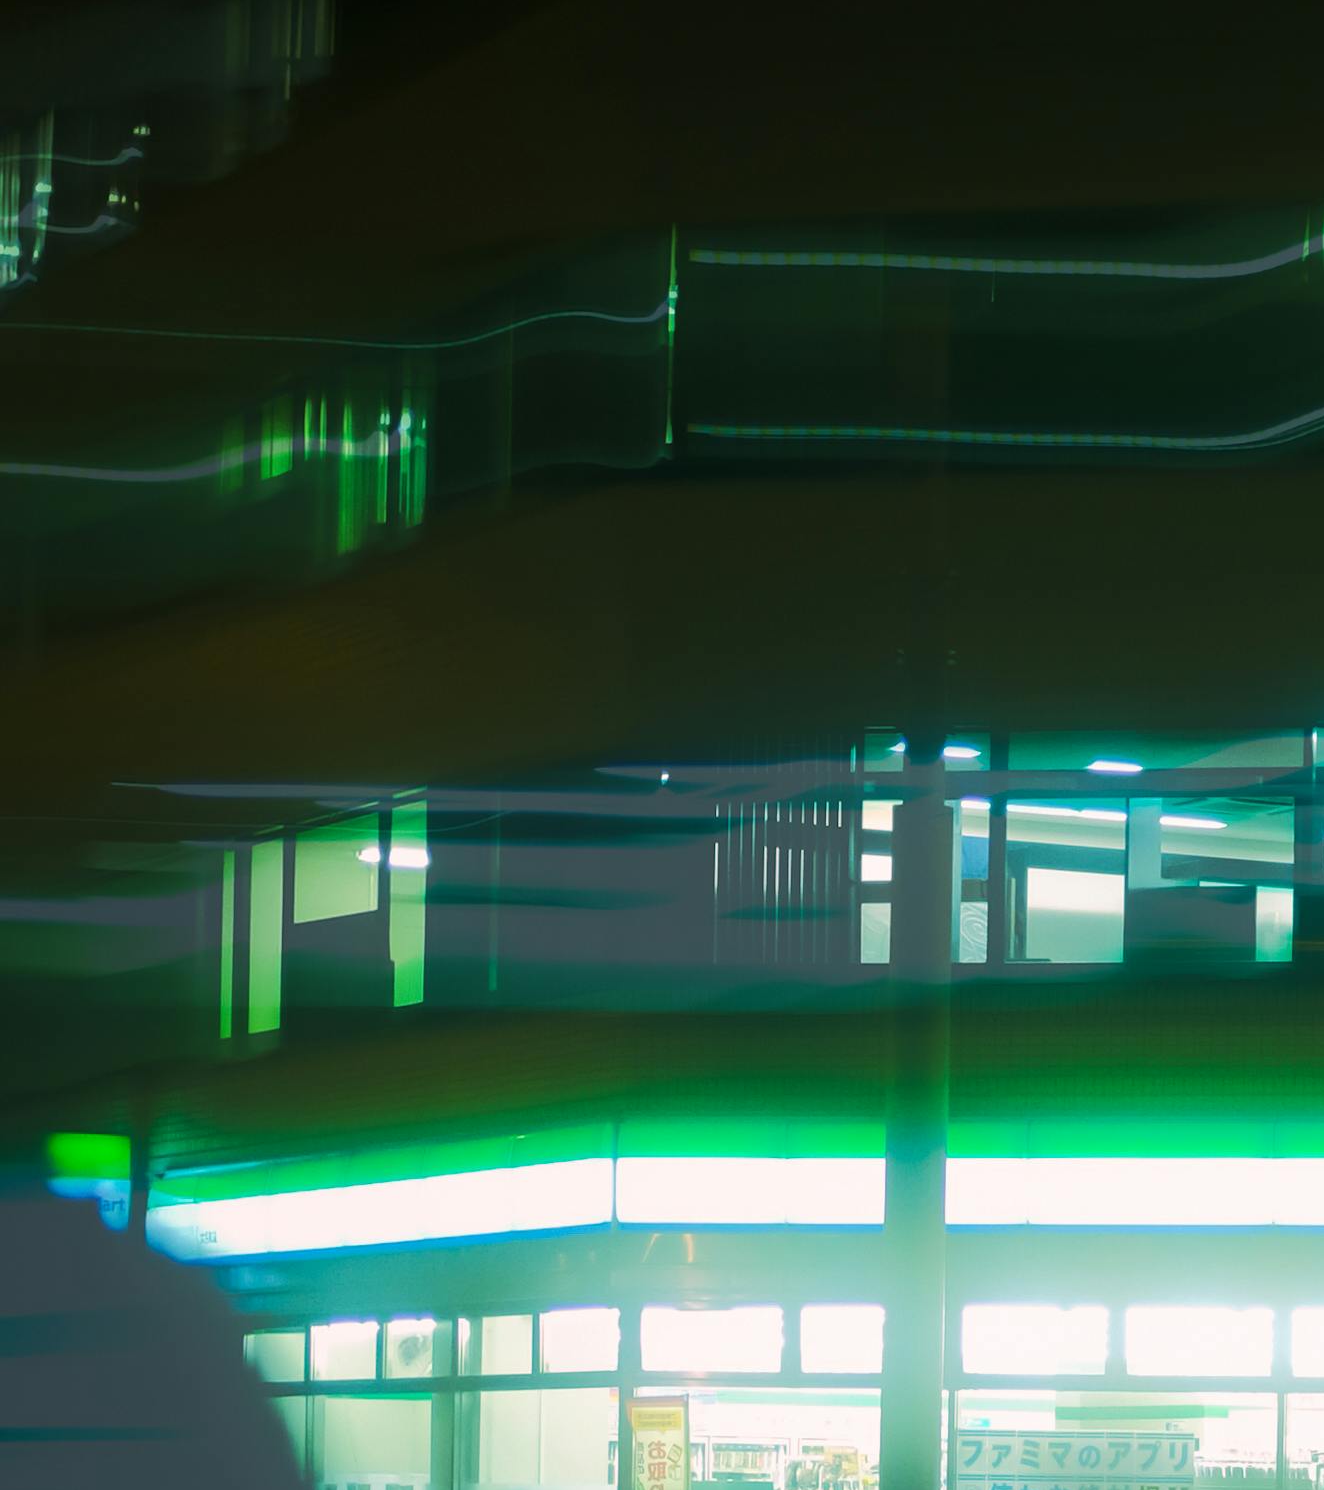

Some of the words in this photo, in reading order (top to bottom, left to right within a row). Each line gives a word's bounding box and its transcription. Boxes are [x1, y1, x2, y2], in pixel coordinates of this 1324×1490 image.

[961, 1439, 1189, 1471] ファミマのアプリ
